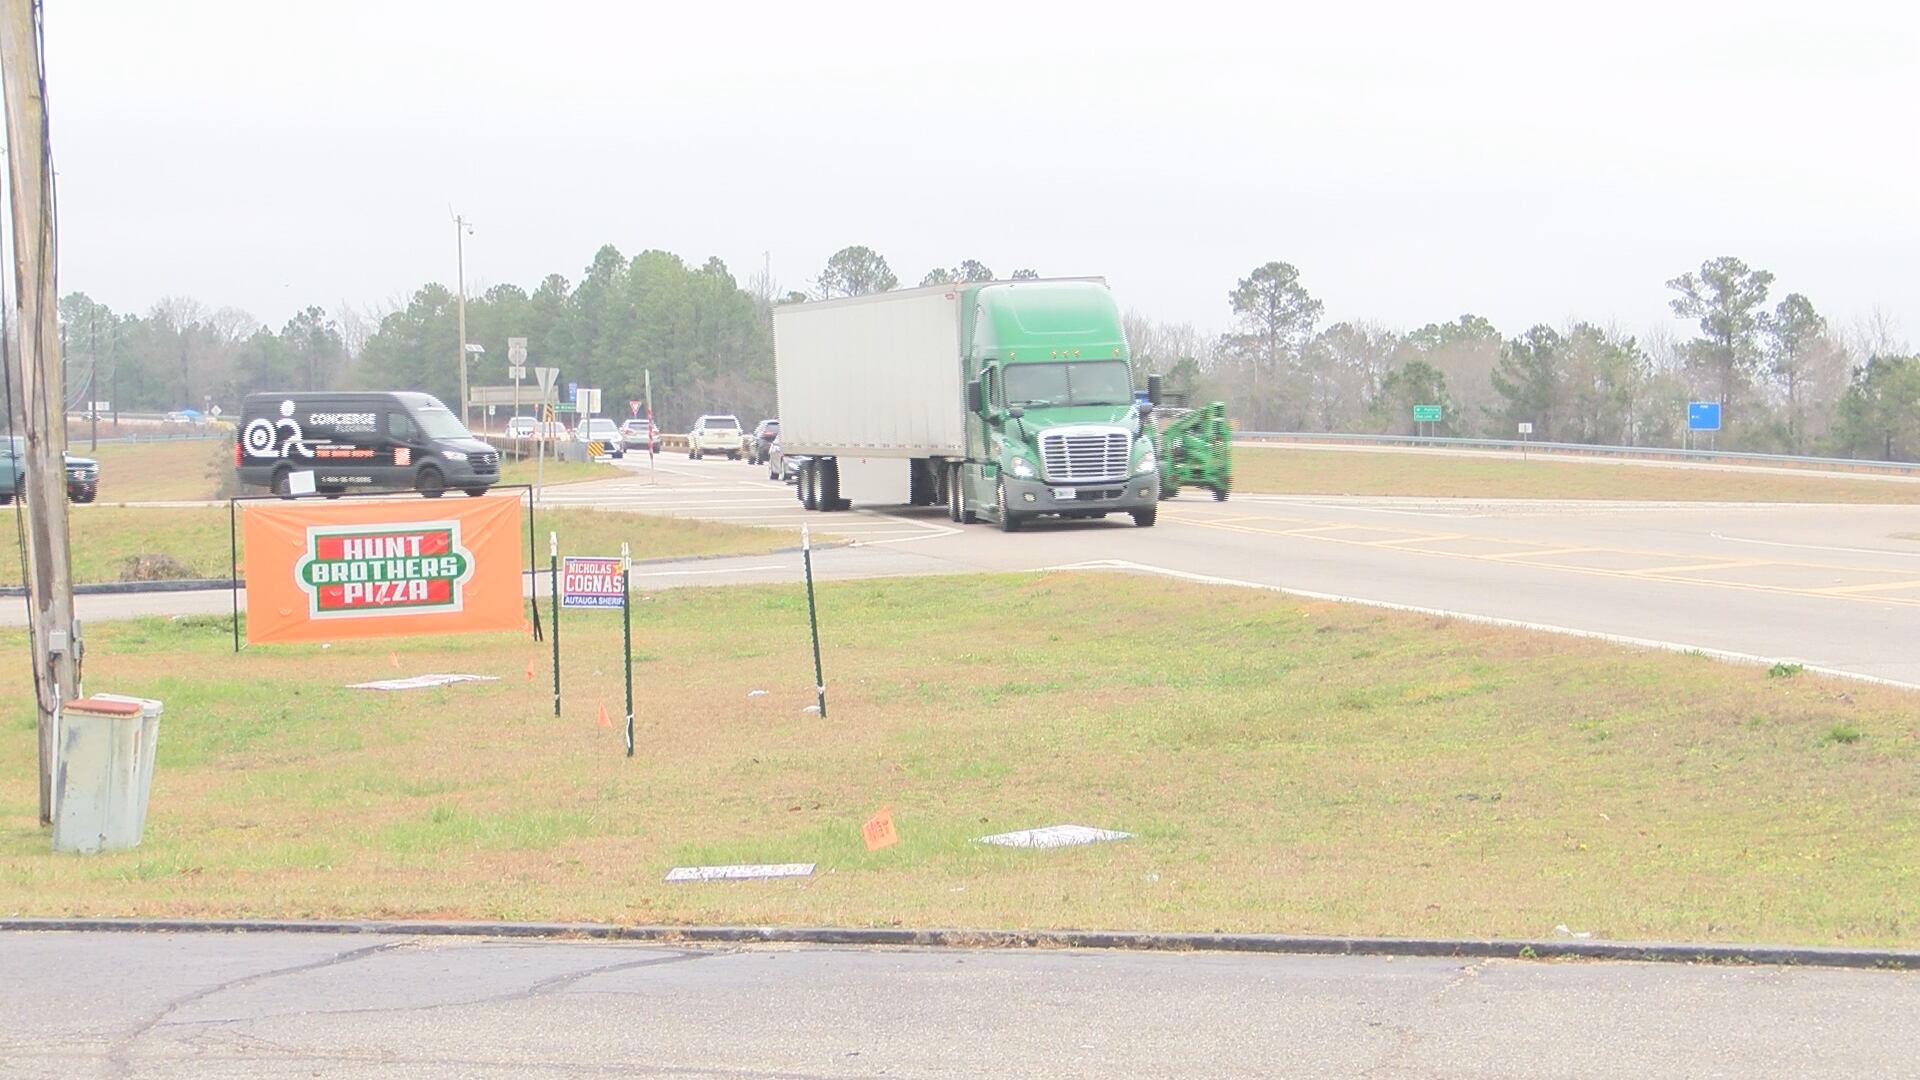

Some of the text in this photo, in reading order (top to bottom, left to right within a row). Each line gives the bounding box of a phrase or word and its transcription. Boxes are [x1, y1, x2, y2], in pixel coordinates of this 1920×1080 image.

[309, 413, 377, 425] CONCIERGE
[343, 535, 424, 561] HUNT
[311, 556, 458, 583] BROTHERS
[568, 563, 612, 574] NICHOLAS
[343, 579, 428, 604] PIZZA
[566, 574, 625, 593] COGNAS
[564, 596, 598, 605] AUTAUGA
